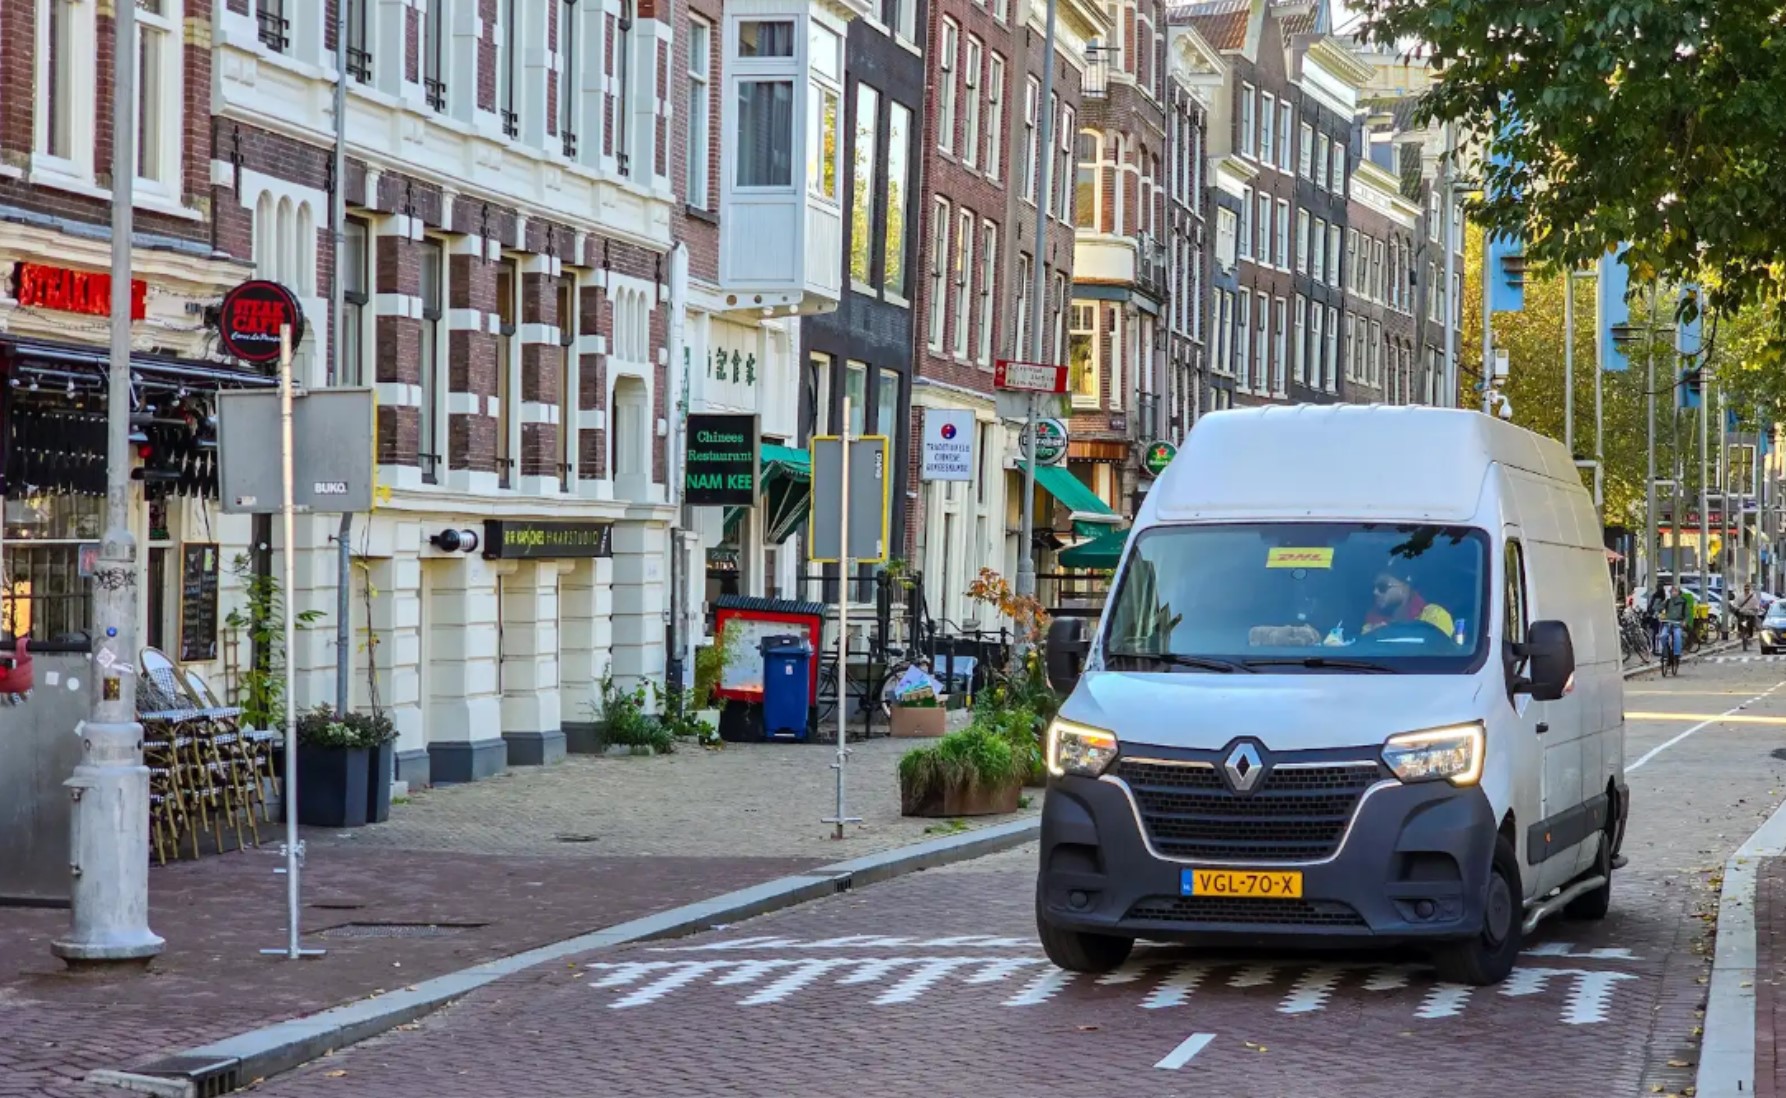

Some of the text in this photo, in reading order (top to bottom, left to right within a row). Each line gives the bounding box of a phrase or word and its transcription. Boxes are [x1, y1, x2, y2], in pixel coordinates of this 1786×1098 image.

[233, 299, 285, 315] STEAK
[697, 431, 744, 443] Chinees
[688, 450, 752, 461] Restaurant
[686, 474, 752, 490] NAM KEE
[1200, 874, 1293, 894] VGL-70-X
